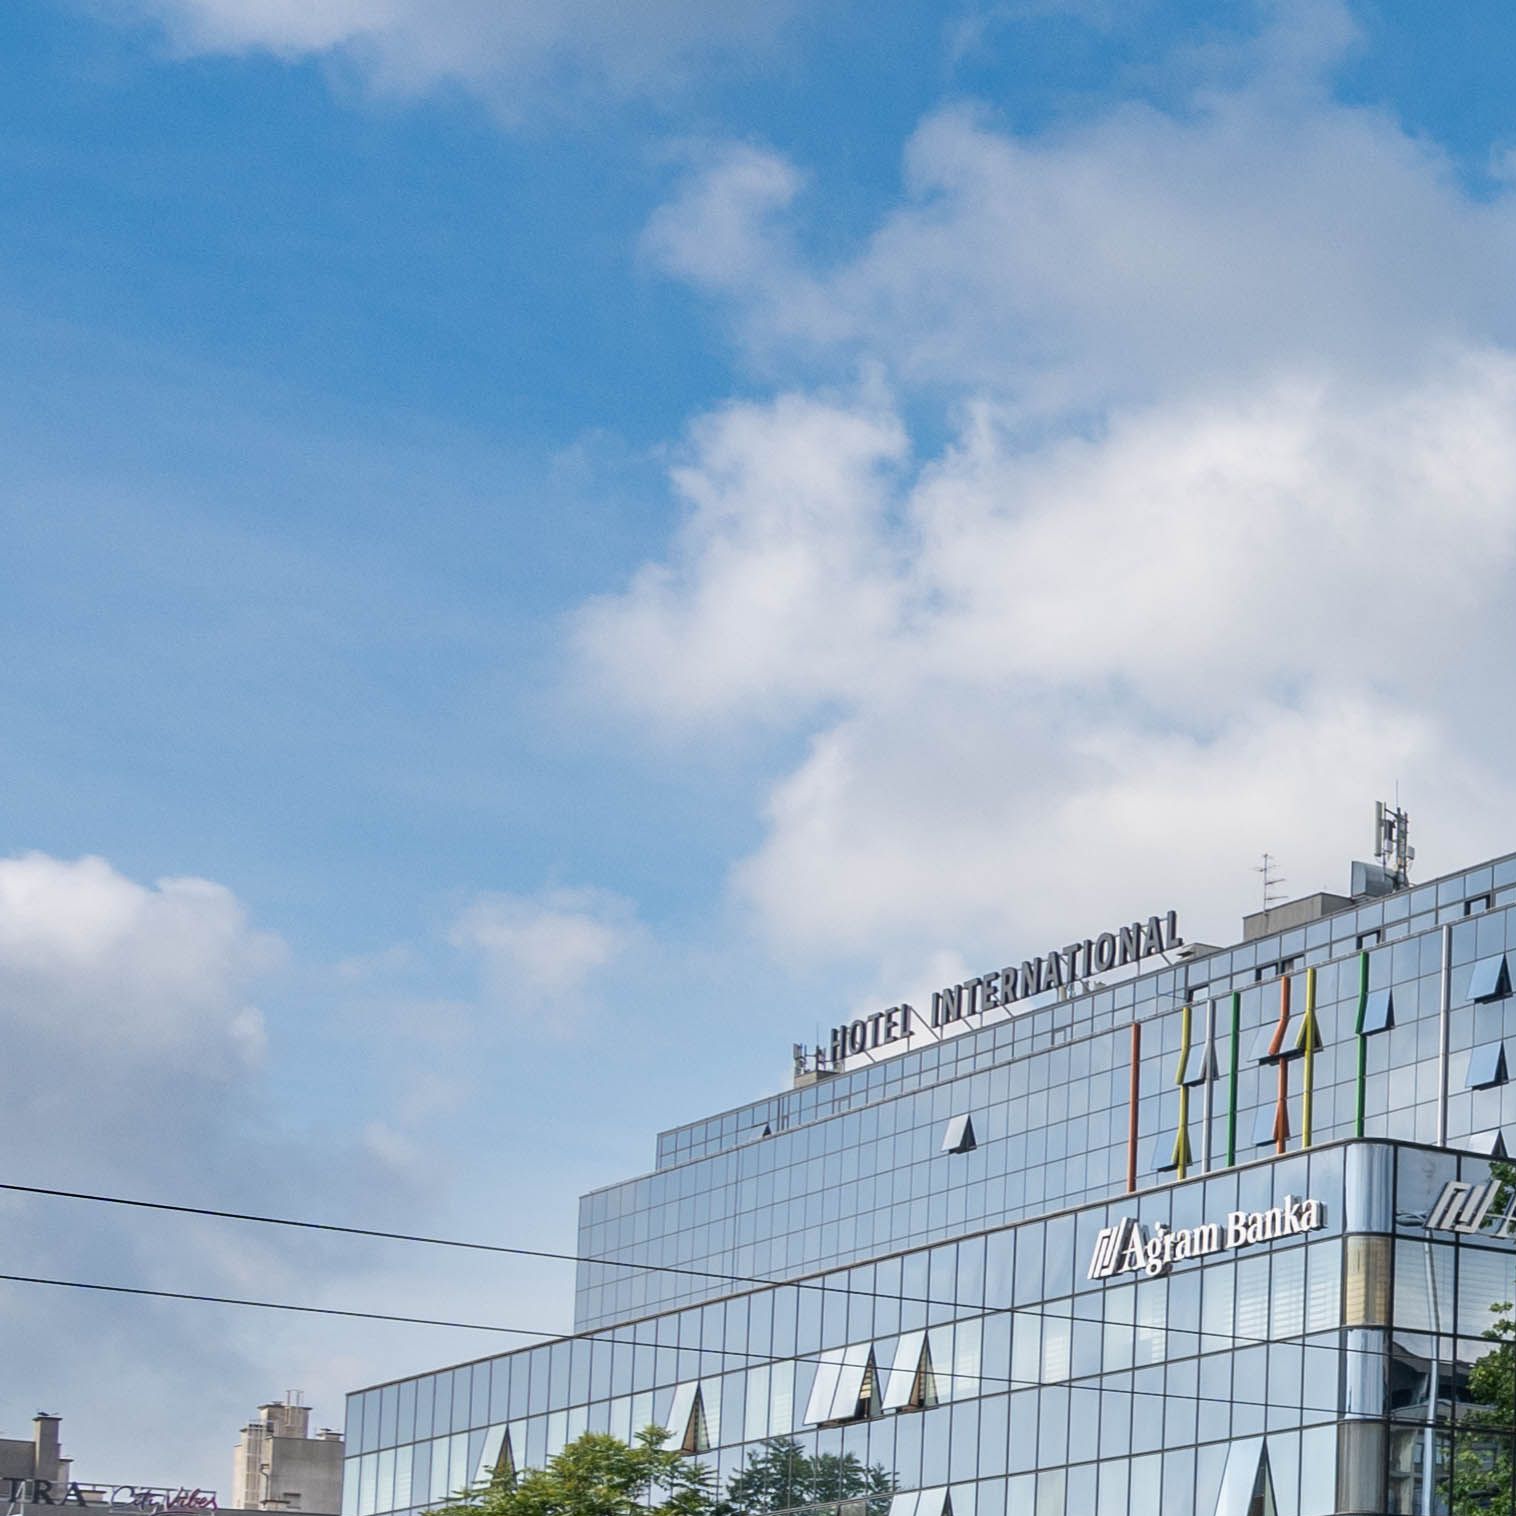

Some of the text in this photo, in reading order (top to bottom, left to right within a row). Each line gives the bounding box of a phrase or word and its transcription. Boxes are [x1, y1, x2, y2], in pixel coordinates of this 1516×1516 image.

[831, 910, 1184, 1061] HOTEL INTERNATIONAL
[1119, 1194, 1326, 1276] Agram Banka
